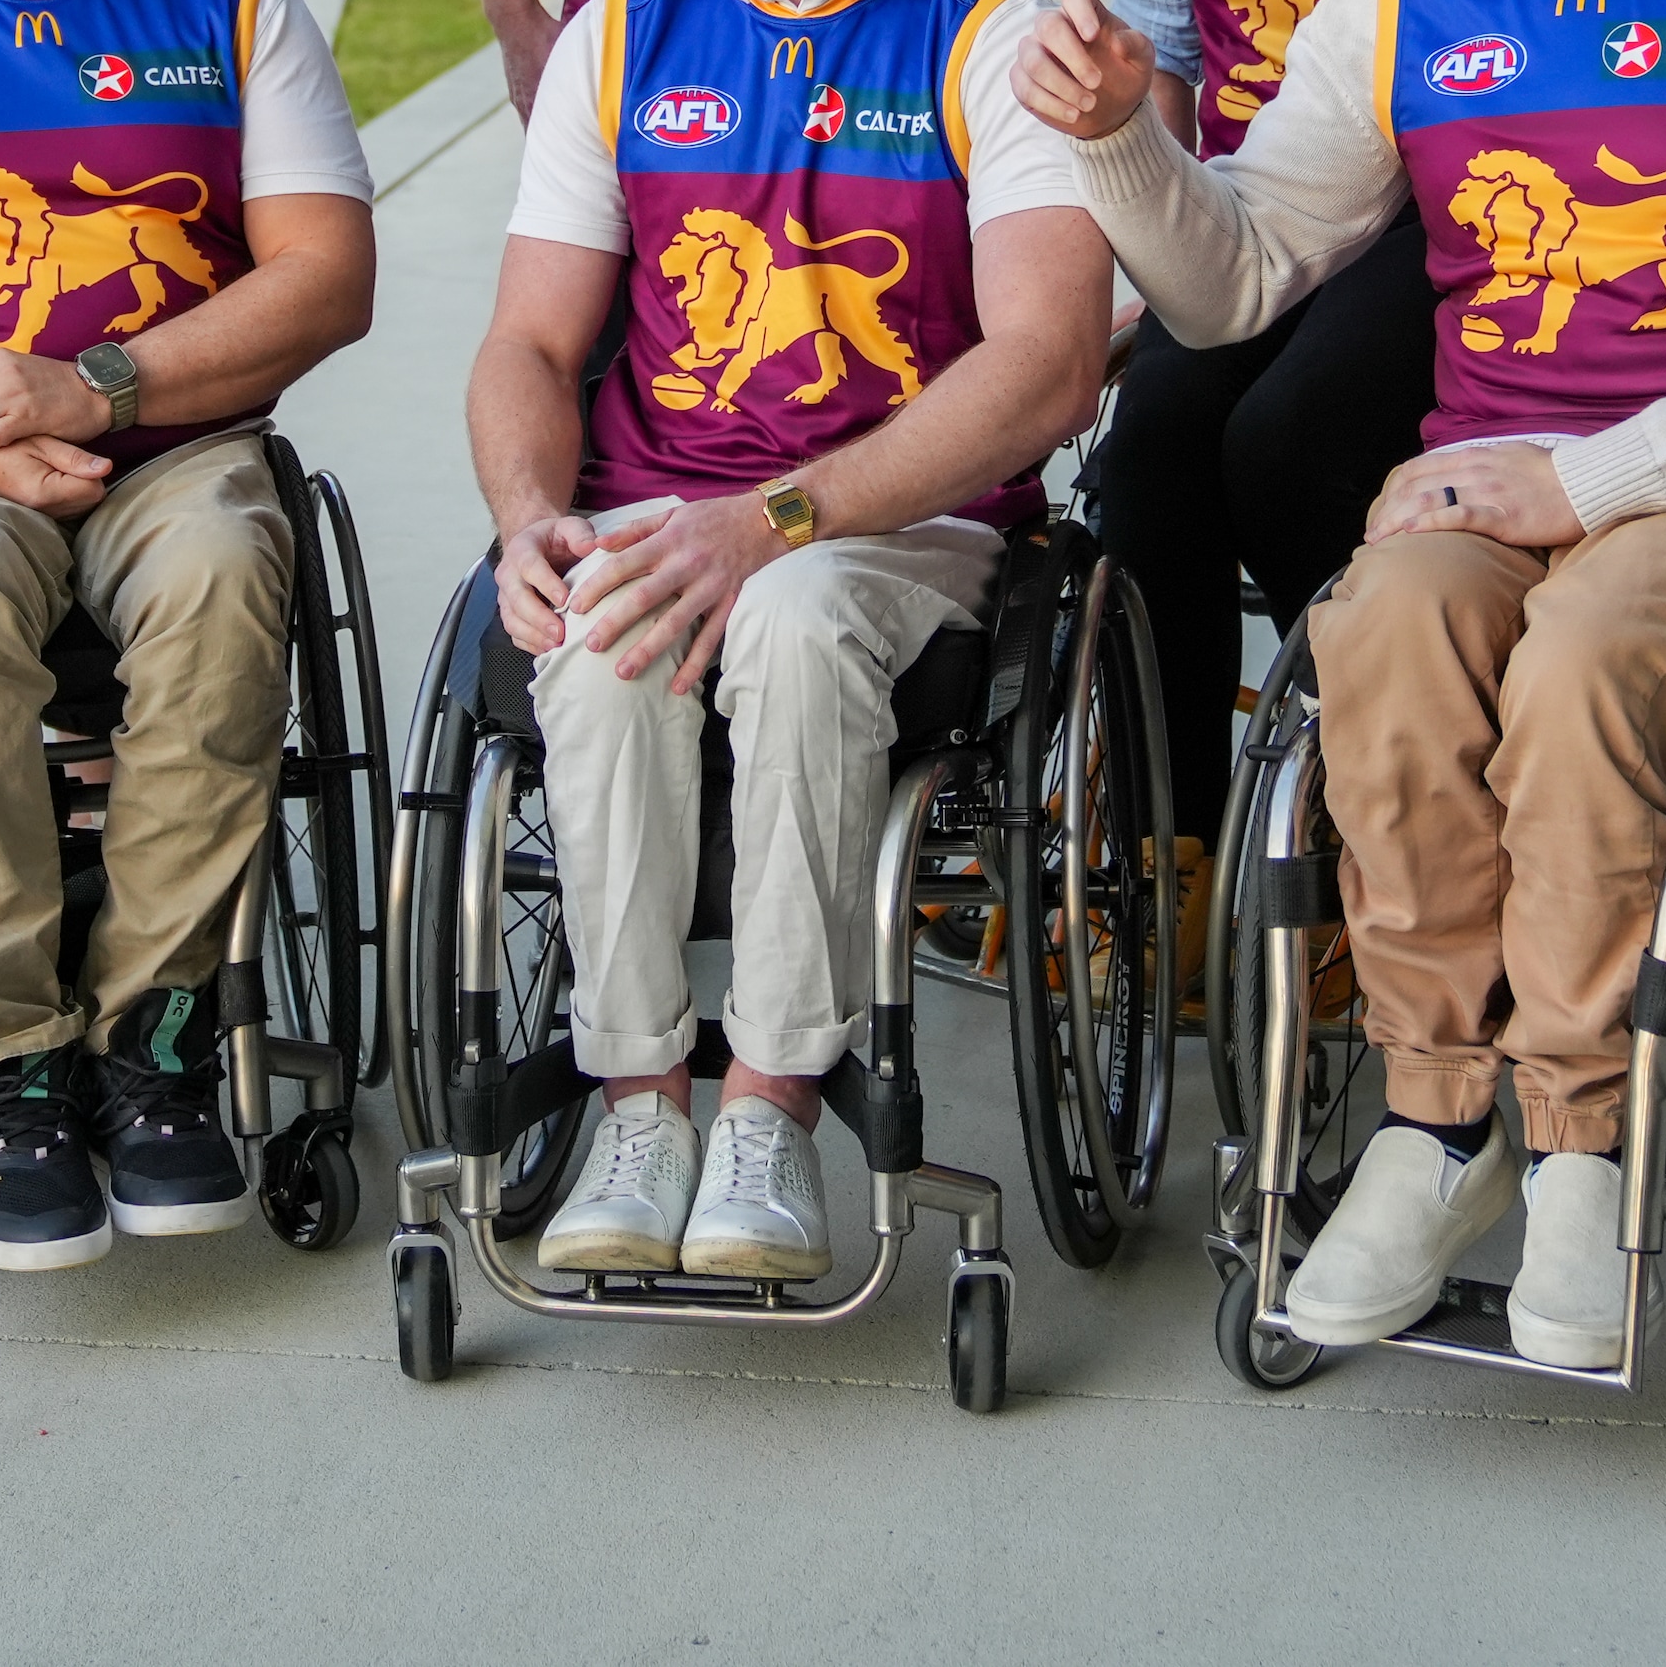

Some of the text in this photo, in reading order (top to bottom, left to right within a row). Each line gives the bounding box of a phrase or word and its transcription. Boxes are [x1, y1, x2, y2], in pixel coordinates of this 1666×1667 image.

[145, 65, 223, 88] CALTEX
[1431, 47, 1516, 82] AFL
[643, 101, 729, 131] AFL
[856, 109, 934, 138] CALTEX
[1109, 956, 1131, 1116] SPINERGY
